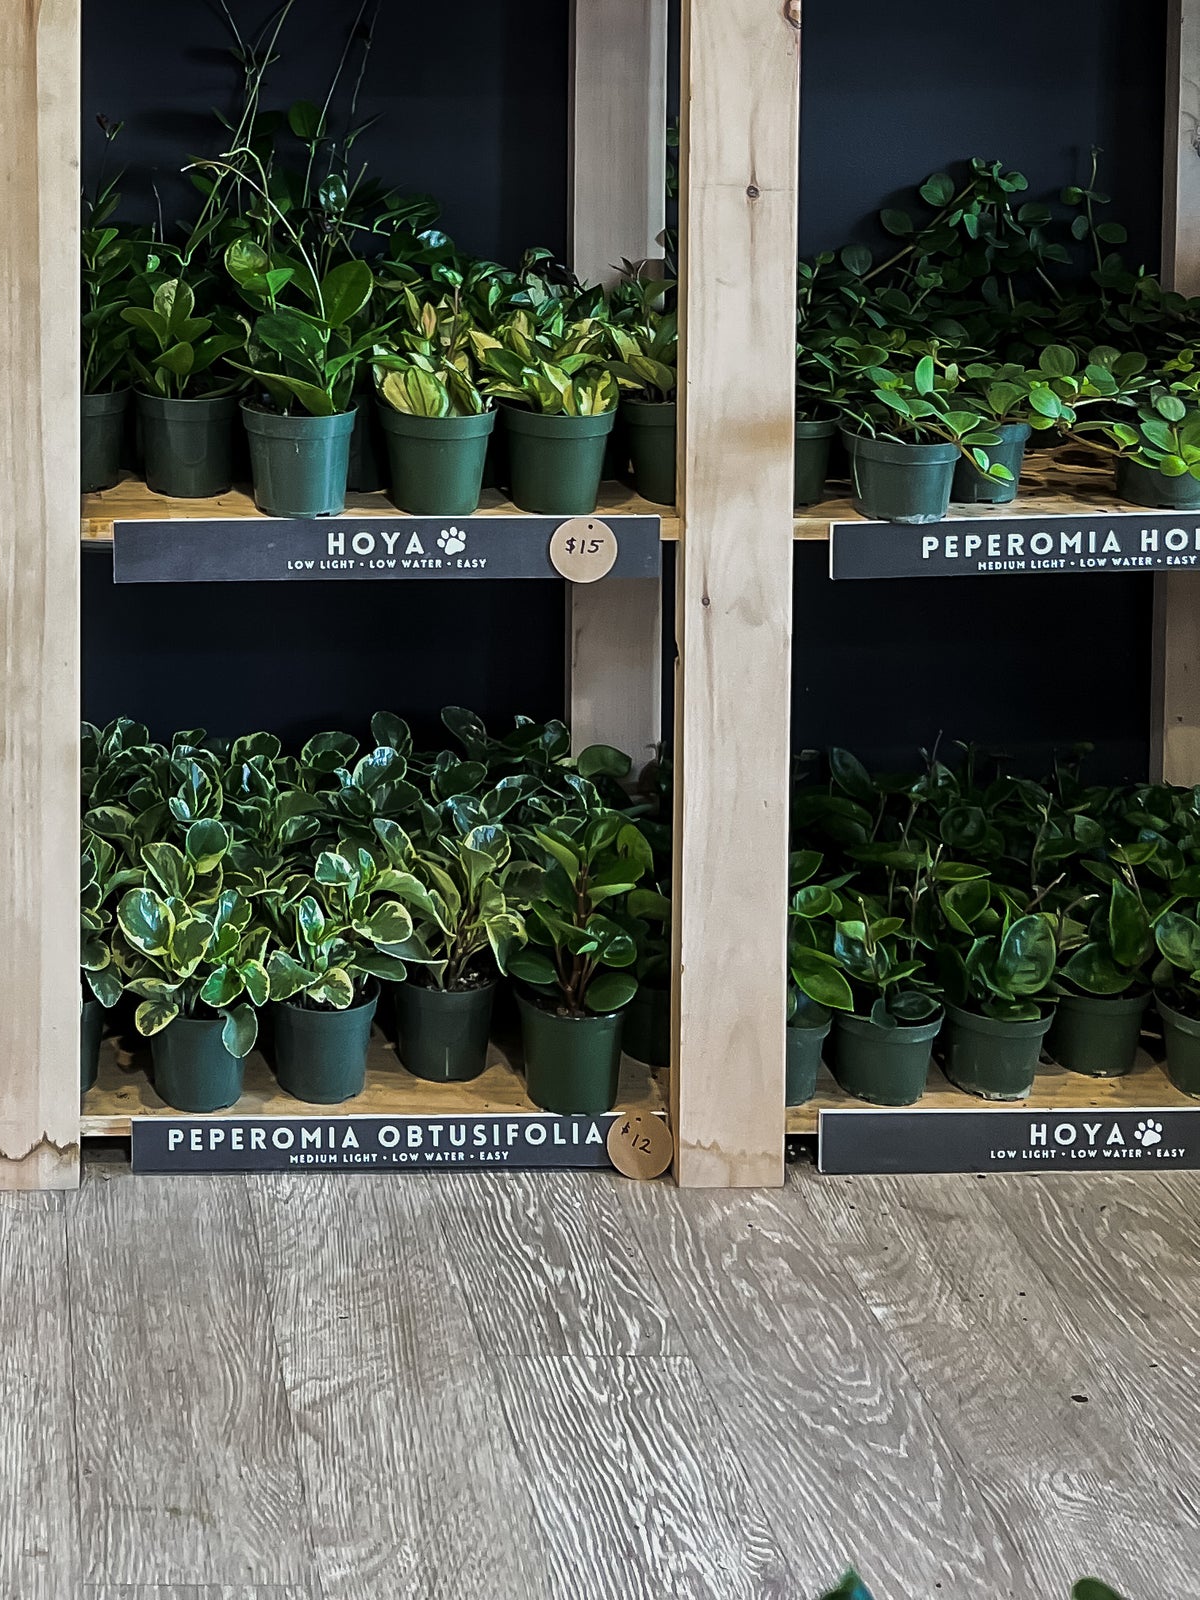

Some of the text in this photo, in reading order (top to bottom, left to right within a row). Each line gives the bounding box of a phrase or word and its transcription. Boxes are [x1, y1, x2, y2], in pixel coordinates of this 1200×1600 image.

[328, 532, 424, 555] HOYA
[923, 530, 1120, 558] PEPEROMIA
[287, 558, 487, 570] LOW LIGHT LOW WATER EASY
[978, 555, 1197, 571] MEDIUM LIGHT LOW WATER EASY
[169, 1122, 602, 1150] PEPEROMIA OBTUSIFOLIA
[1031, 1123, 1124, 1145] HOYA
[289, 1151, 509, 1164] MEDIUM LIGHT LOW WATER EASY
[990, 1148, 1185, 1159] LOW LIGHT LOW WATER EASY
